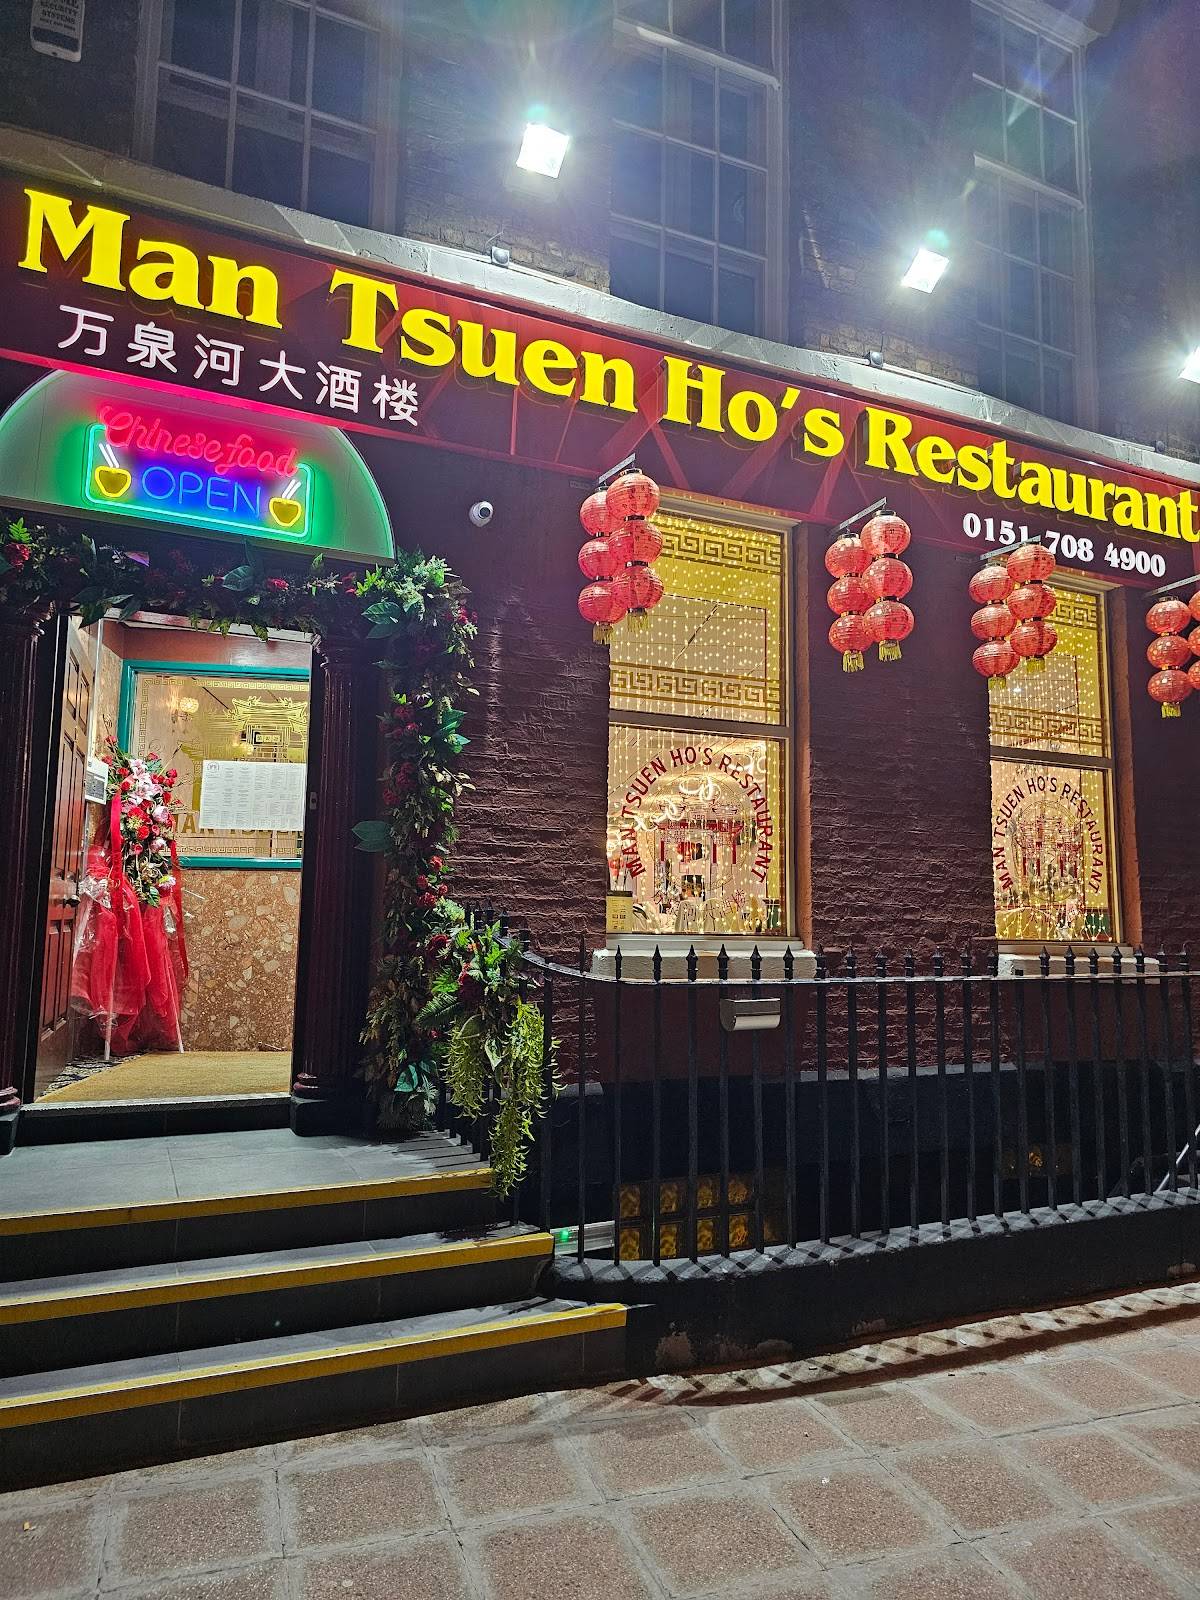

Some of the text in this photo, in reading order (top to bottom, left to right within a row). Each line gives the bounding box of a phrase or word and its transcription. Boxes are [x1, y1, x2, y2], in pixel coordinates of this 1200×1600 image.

[17, 188, 1200, 543] Man Tsuen Ho's Restaurant
[58, 304, 419, 427] 万泉河大酒楼
[99, 406, 299, 477] Chinese food
[141, 466, 261, 519] OPEN
[962, 512, 1166, 578] 0151 708 4900
[619, 746, 774, 884] MAN TSUEN HO'S RESTAURANT
[992, 775, 1104, 894] MAN TSUEN HO'S RESTAURANT
